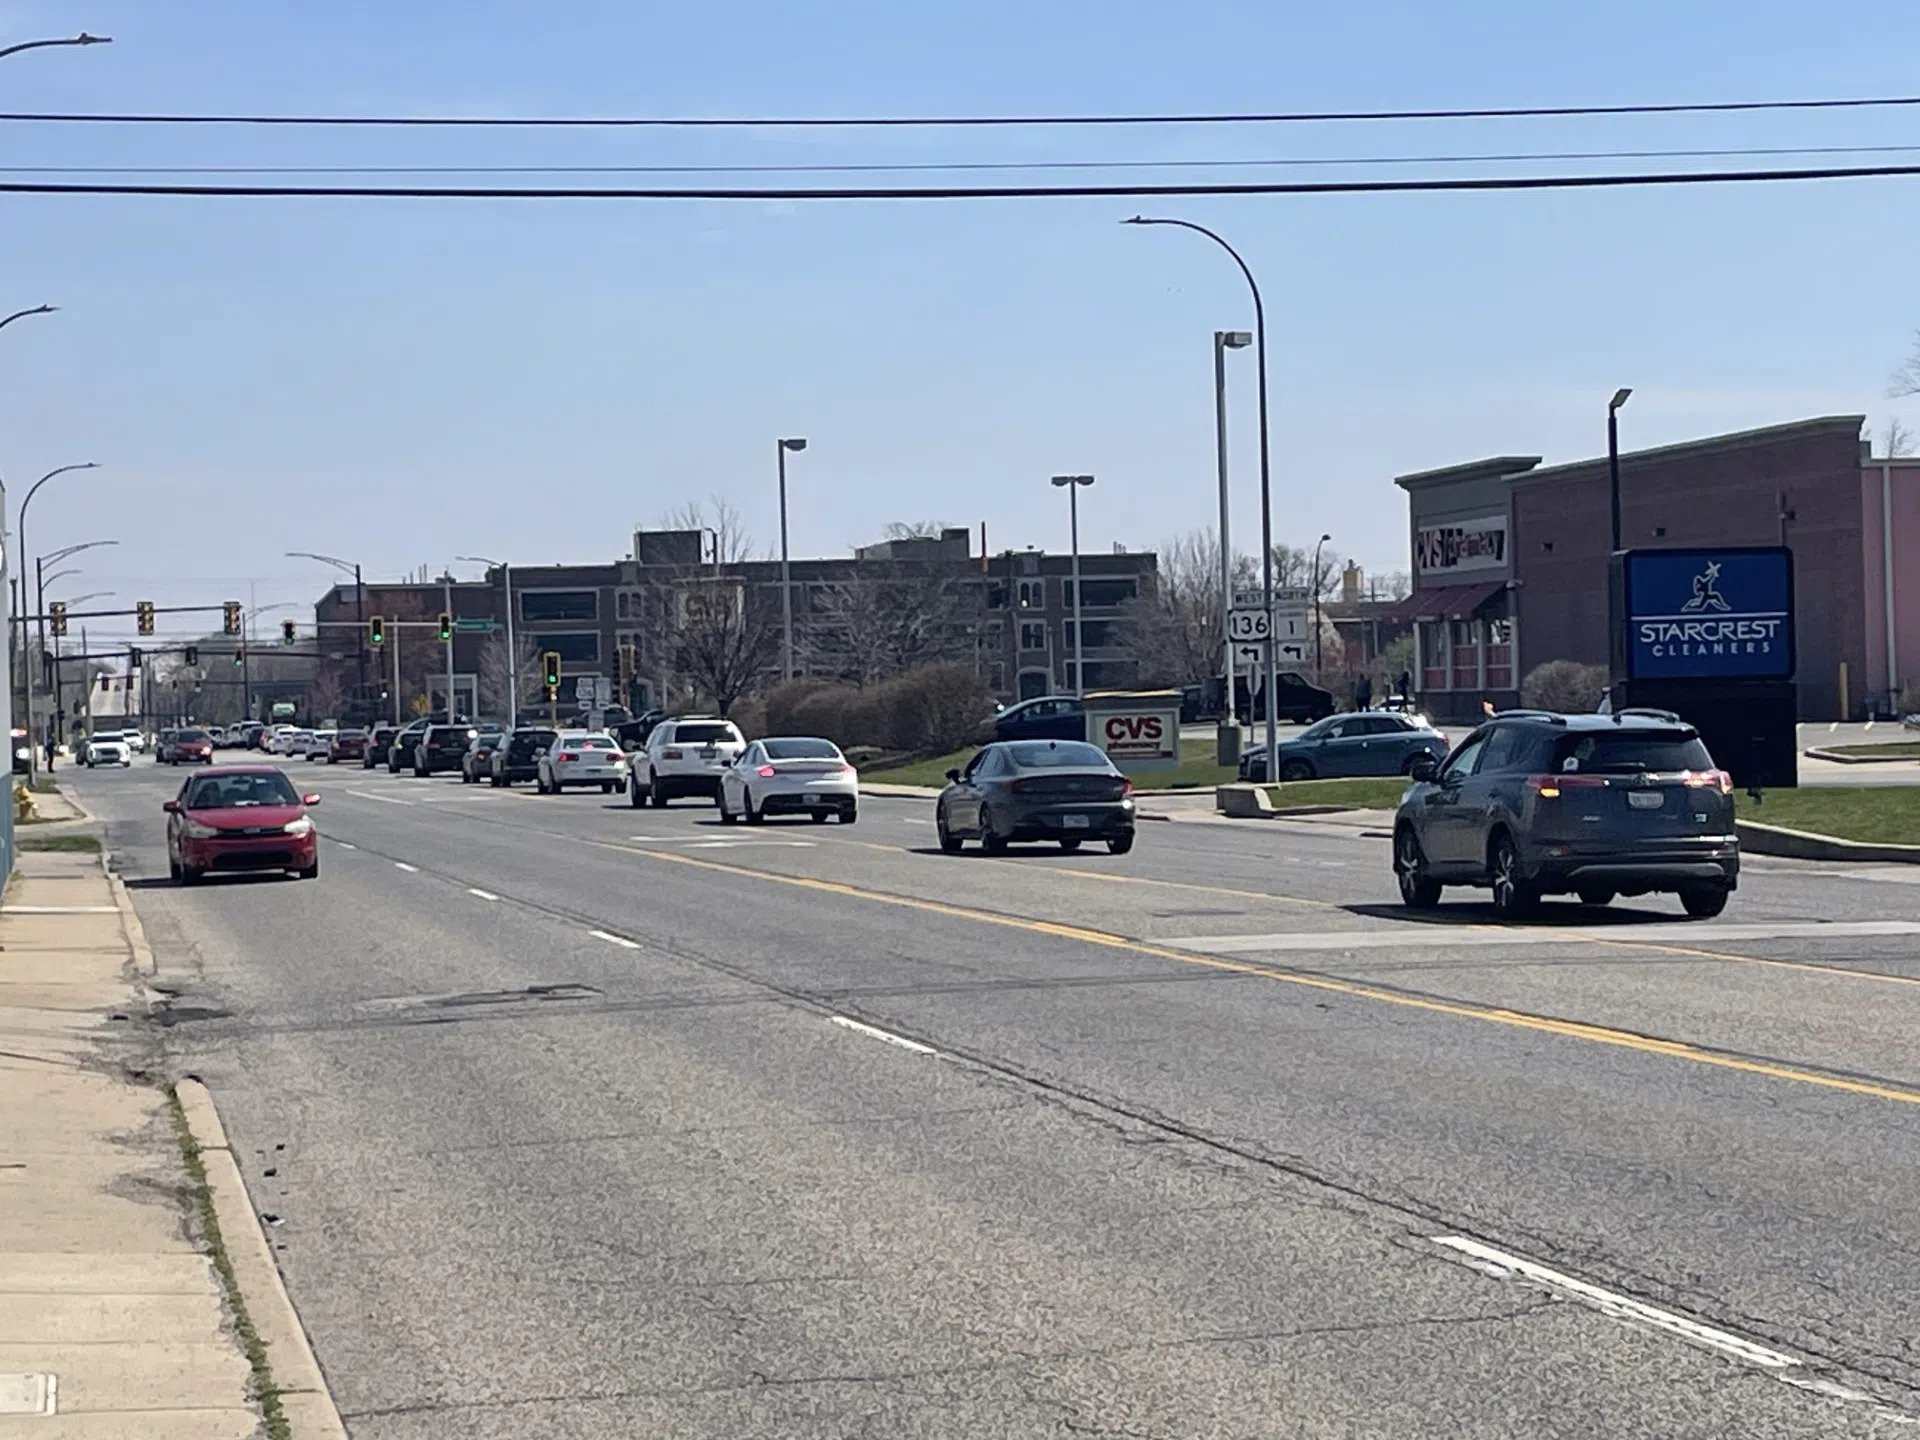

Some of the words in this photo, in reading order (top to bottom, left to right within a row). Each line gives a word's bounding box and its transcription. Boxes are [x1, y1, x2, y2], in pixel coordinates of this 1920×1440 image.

[1235, 592, 1262, 604] WEST
[1232, 616, 1268, 635] 136
[1288, 620, 1295, 635] 1
[1640, 620, 1781, 643] STARCREST
[1652, 641, 1771, 657] CLEANERS
[1105, 716, 1163, 740] CVS
